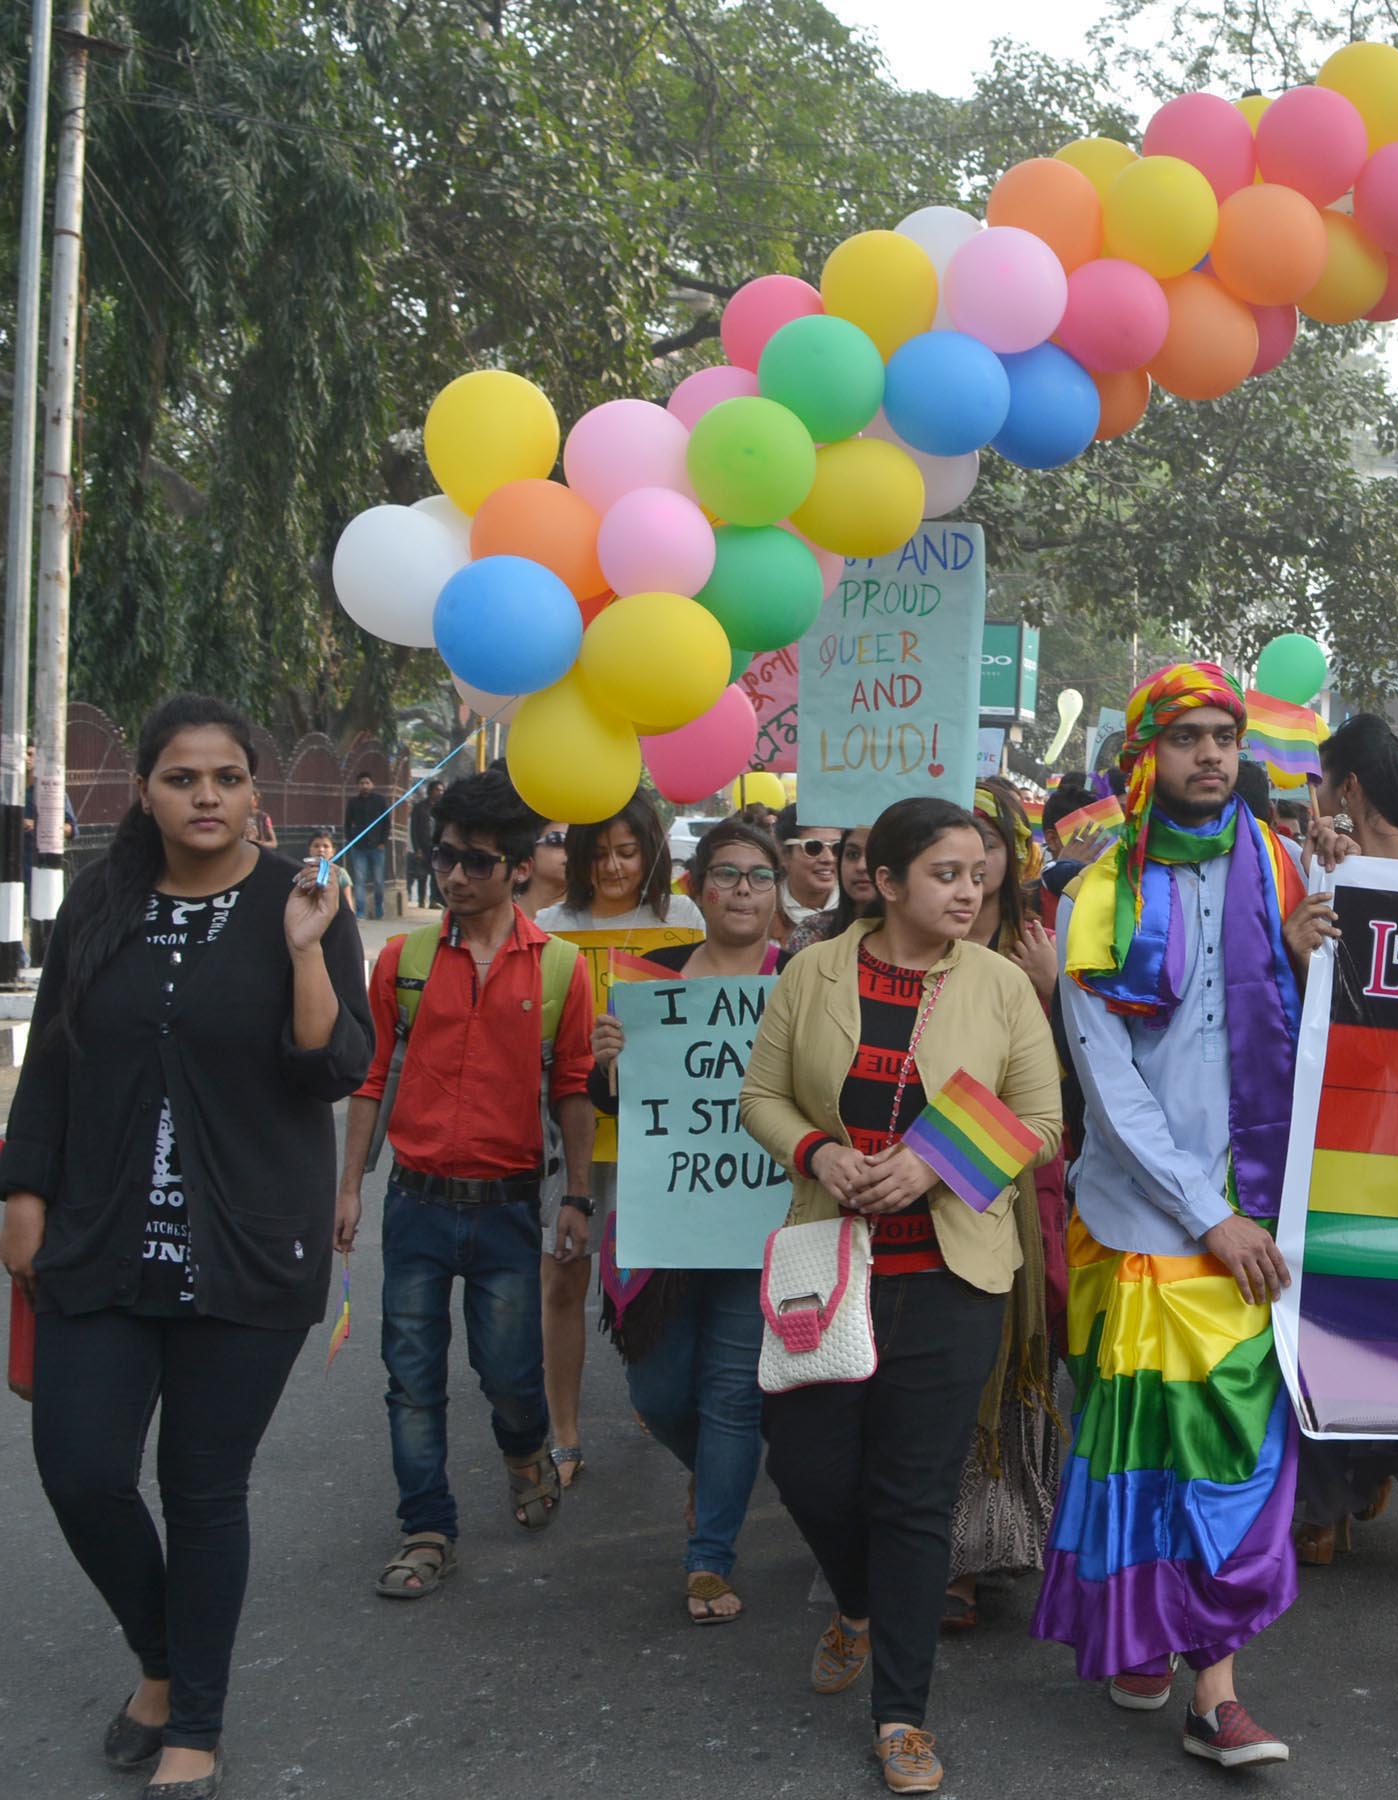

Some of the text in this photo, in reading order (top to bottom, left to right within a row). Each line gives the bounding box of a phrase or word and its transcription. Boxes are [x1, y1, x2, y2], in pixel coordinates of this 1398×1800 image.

[897, 529, 974, 575] AND
[839, 580, 941, 618] PROUD
[819, 631, 922, 677] QUEER
[851, 673, 922, 713] AND
[820, 722, 938, 776] LOUD!
[654, 987, 687, 1025] I
[685, 1041, 754, 1079] GA
[641, 1098, 669, 1137] I
